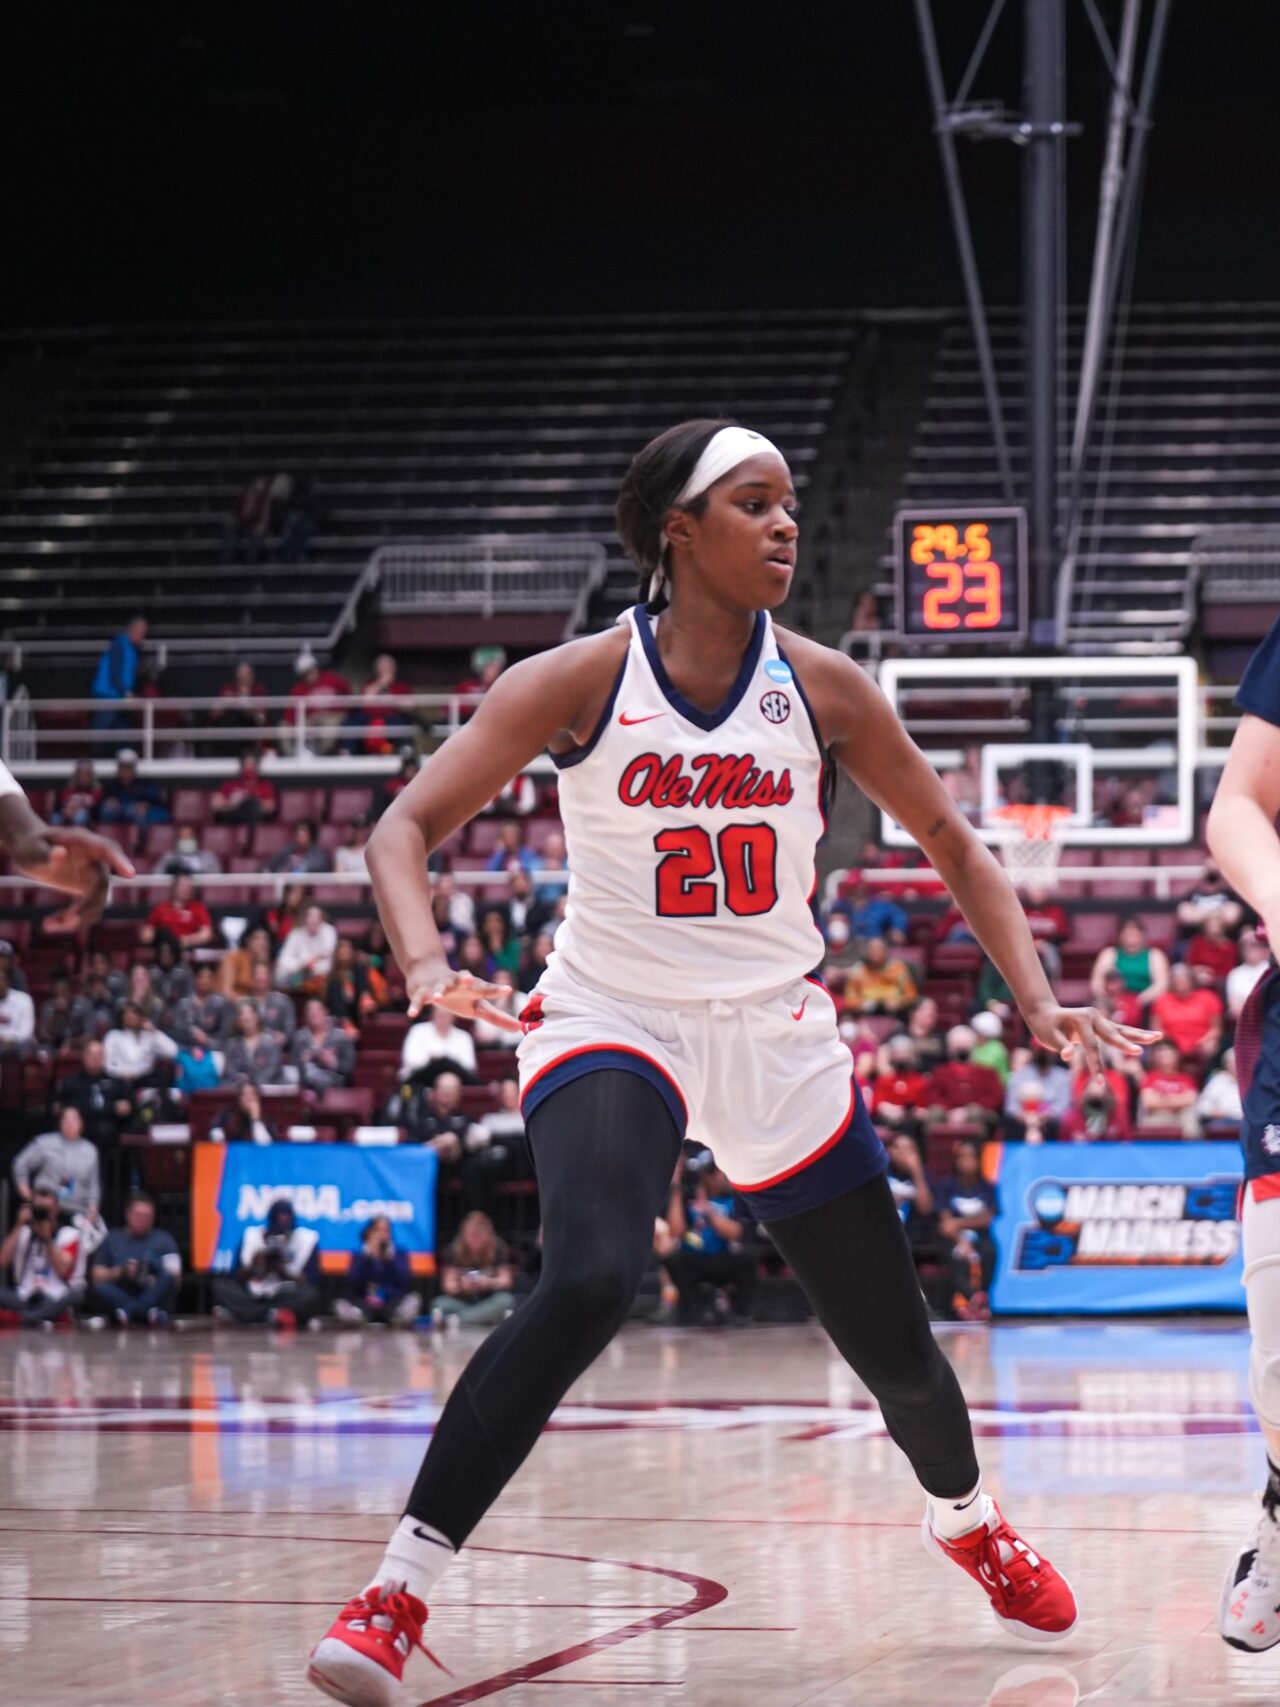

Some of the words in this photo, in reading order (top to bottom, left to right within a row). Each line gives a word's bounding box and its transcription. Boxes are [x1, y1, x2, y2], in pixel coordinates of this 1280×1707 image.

[923, 562, 1001, 629] 23
[761, 692, 791, 723] SEC
[618, 752, 693, 808] Ole
[690, 753, 795, 809] Miss
[653, 822, 778, 917] 20
[1063, 1185, 1187, 1220] MARCH
[1077, 1220, 1240, 1258] MADNESS
